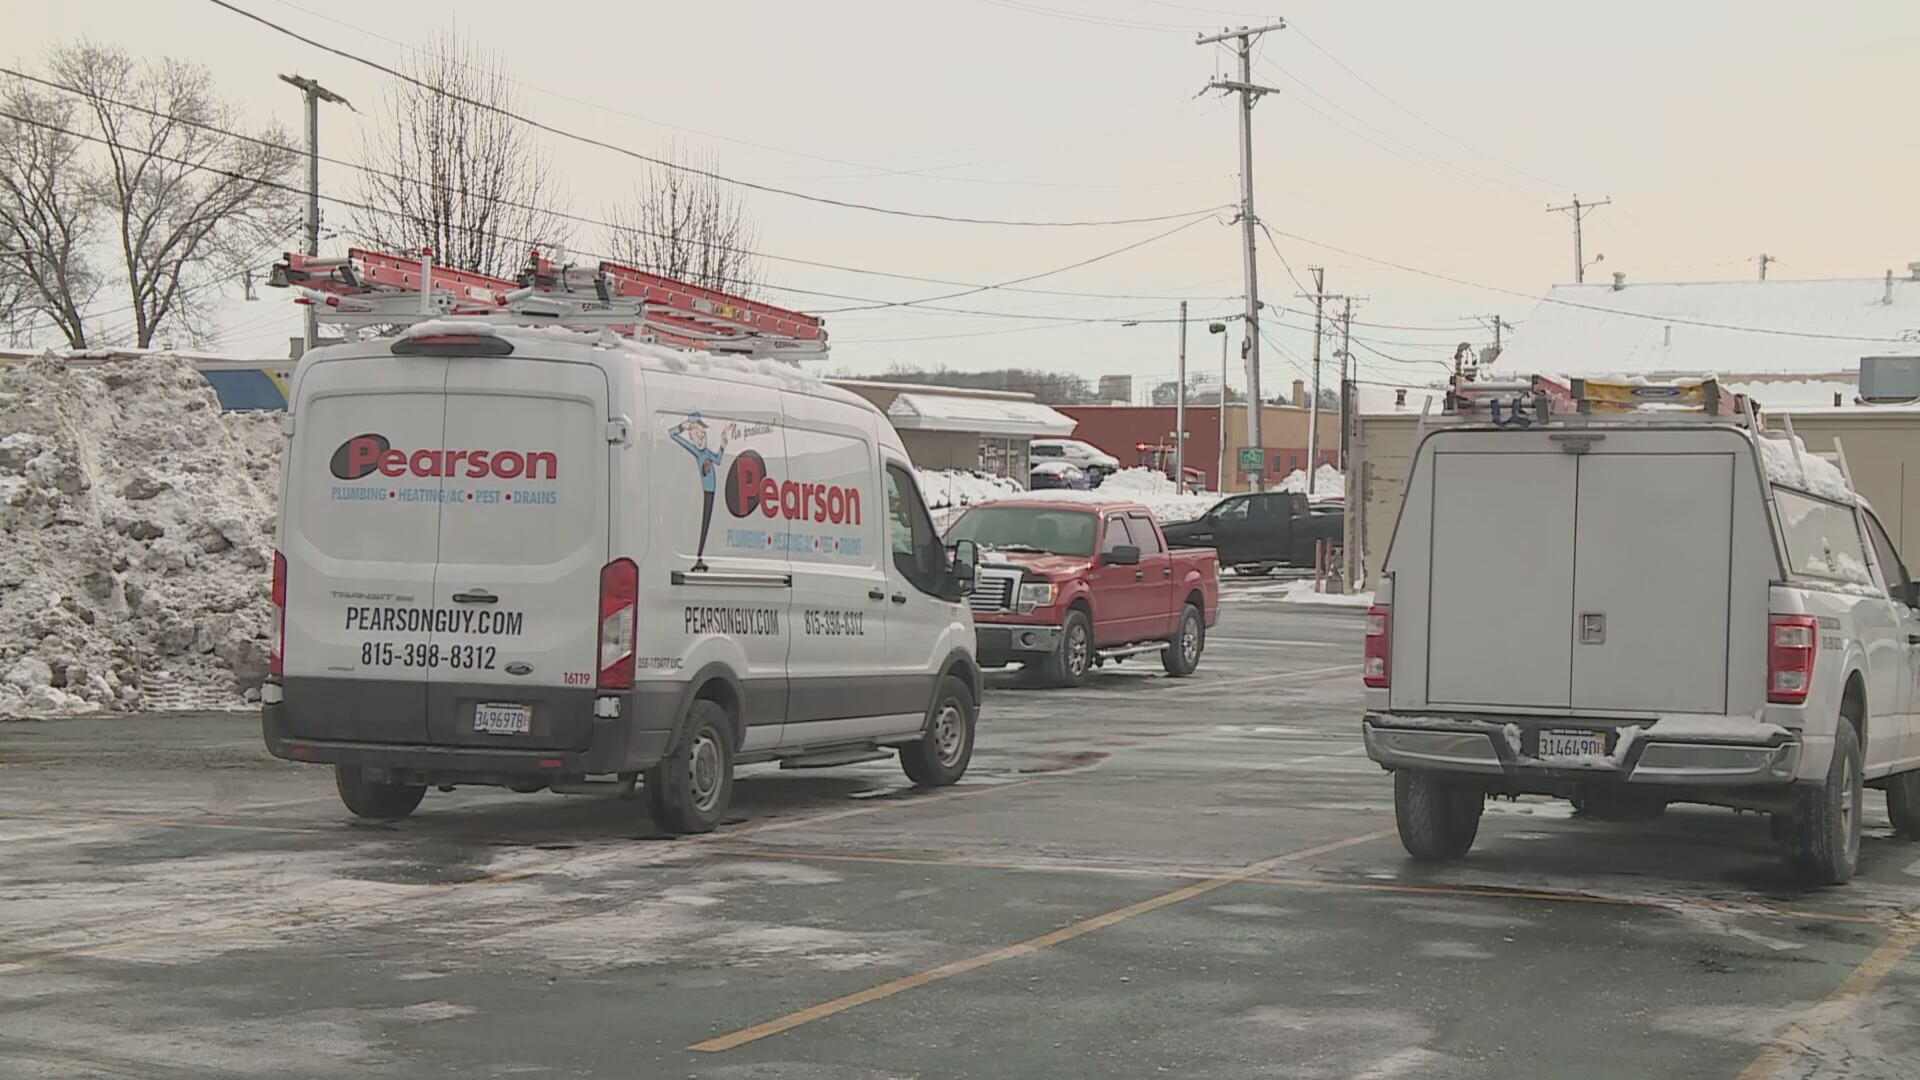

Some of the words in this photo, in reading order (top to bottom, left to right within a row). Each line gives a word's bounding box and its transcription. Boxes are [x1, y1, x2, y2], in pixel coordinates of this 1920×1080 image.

[346, 437, 557, 479] Pearson
[331, 487, 387, 501] PLUMBING
[399, 489, 465, 503] HEATING/AC
[476, 491, 501, 503] PEST
[513, 491, 557, 504] DRAINS
[737, 454, 861, 525] Pearson
[345, 606, 523, 635] PEARSONGUY.COM
[684, 606, 779, 635] PEARSONGUY.COM
[804, 610, 864, 635] 815-398-8312
[361, 642, 496, 670] 815-398-8312
[563, 671, 591, 685] 16119
